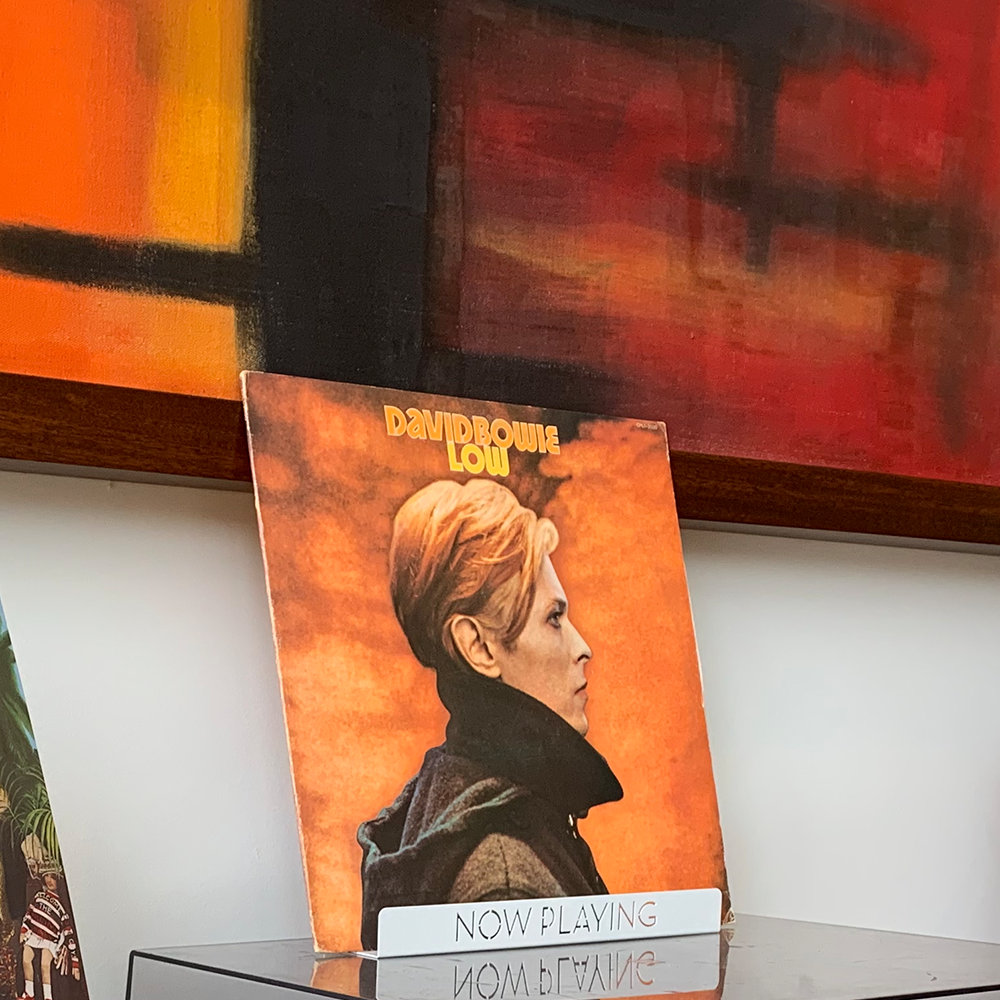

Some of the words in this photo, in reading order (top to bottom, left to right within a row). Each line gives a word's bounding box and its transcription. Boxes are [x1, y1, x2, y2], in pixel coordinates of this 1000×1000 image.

[447, 440, 510, 477] LOW
[455, 906, 532, 942] NOW
[541, 900, 657, 936] PLAYING
